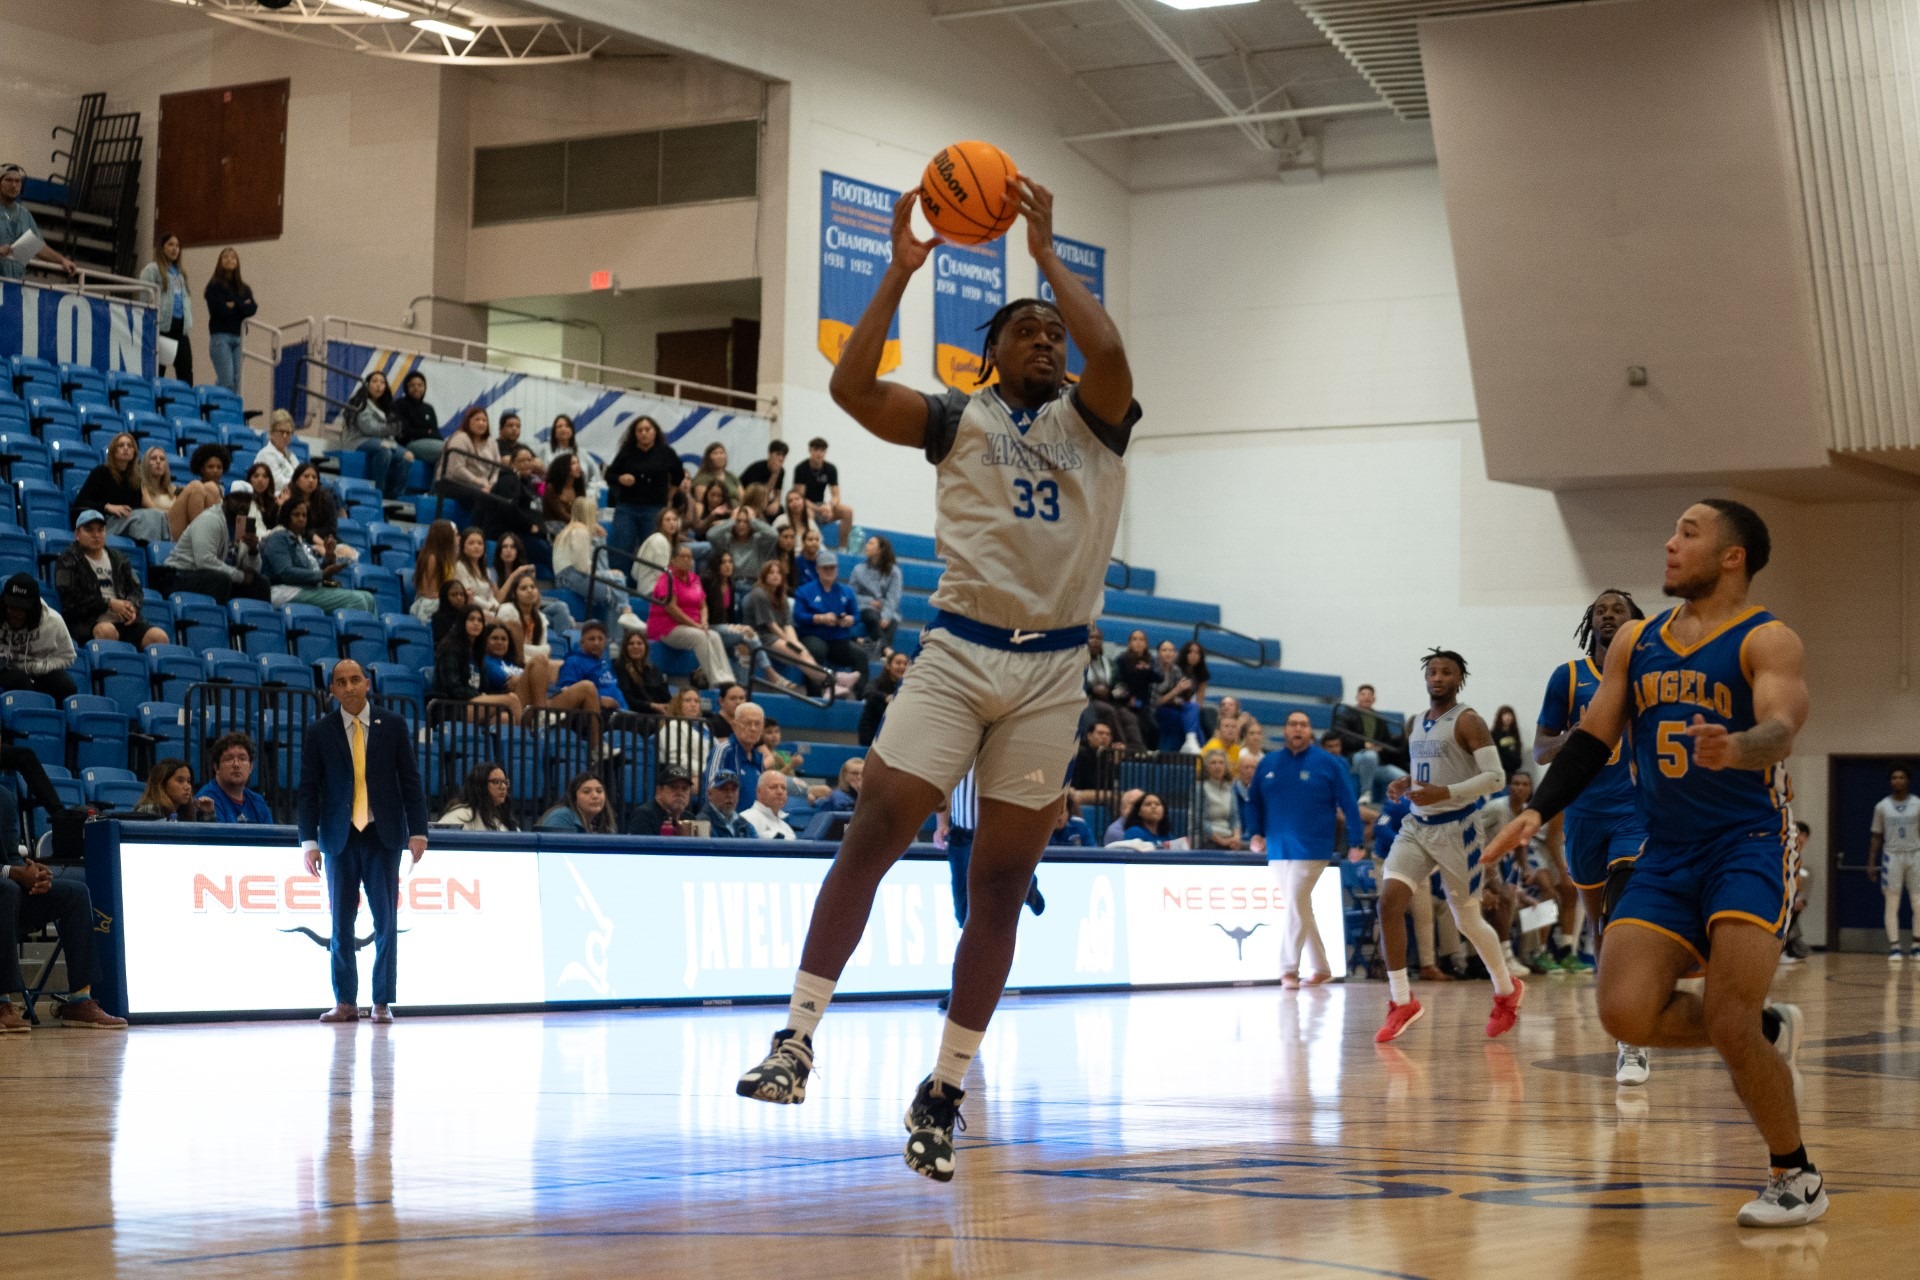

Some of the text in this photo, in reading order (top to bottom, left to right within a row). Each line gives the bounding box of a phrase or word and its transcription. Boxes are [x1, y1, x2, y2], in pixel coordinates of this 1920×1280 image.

[832, 179, 892, 212] FOOTBALL
[921, 186, 941, 217] CAA
[0, 282, 145, 376] ION
[1013, 478, 1060, 522] 33
[1633, 669, 1733, 719] ANGELO
[1656, 720, 1689, 779] 5
[1417, 762, 1430, 784] 10
[193, 873, 482, 911] NEEEN
[1163, 887, 1286, 910] NEESSE
[882, 883, 925, 967] VS
